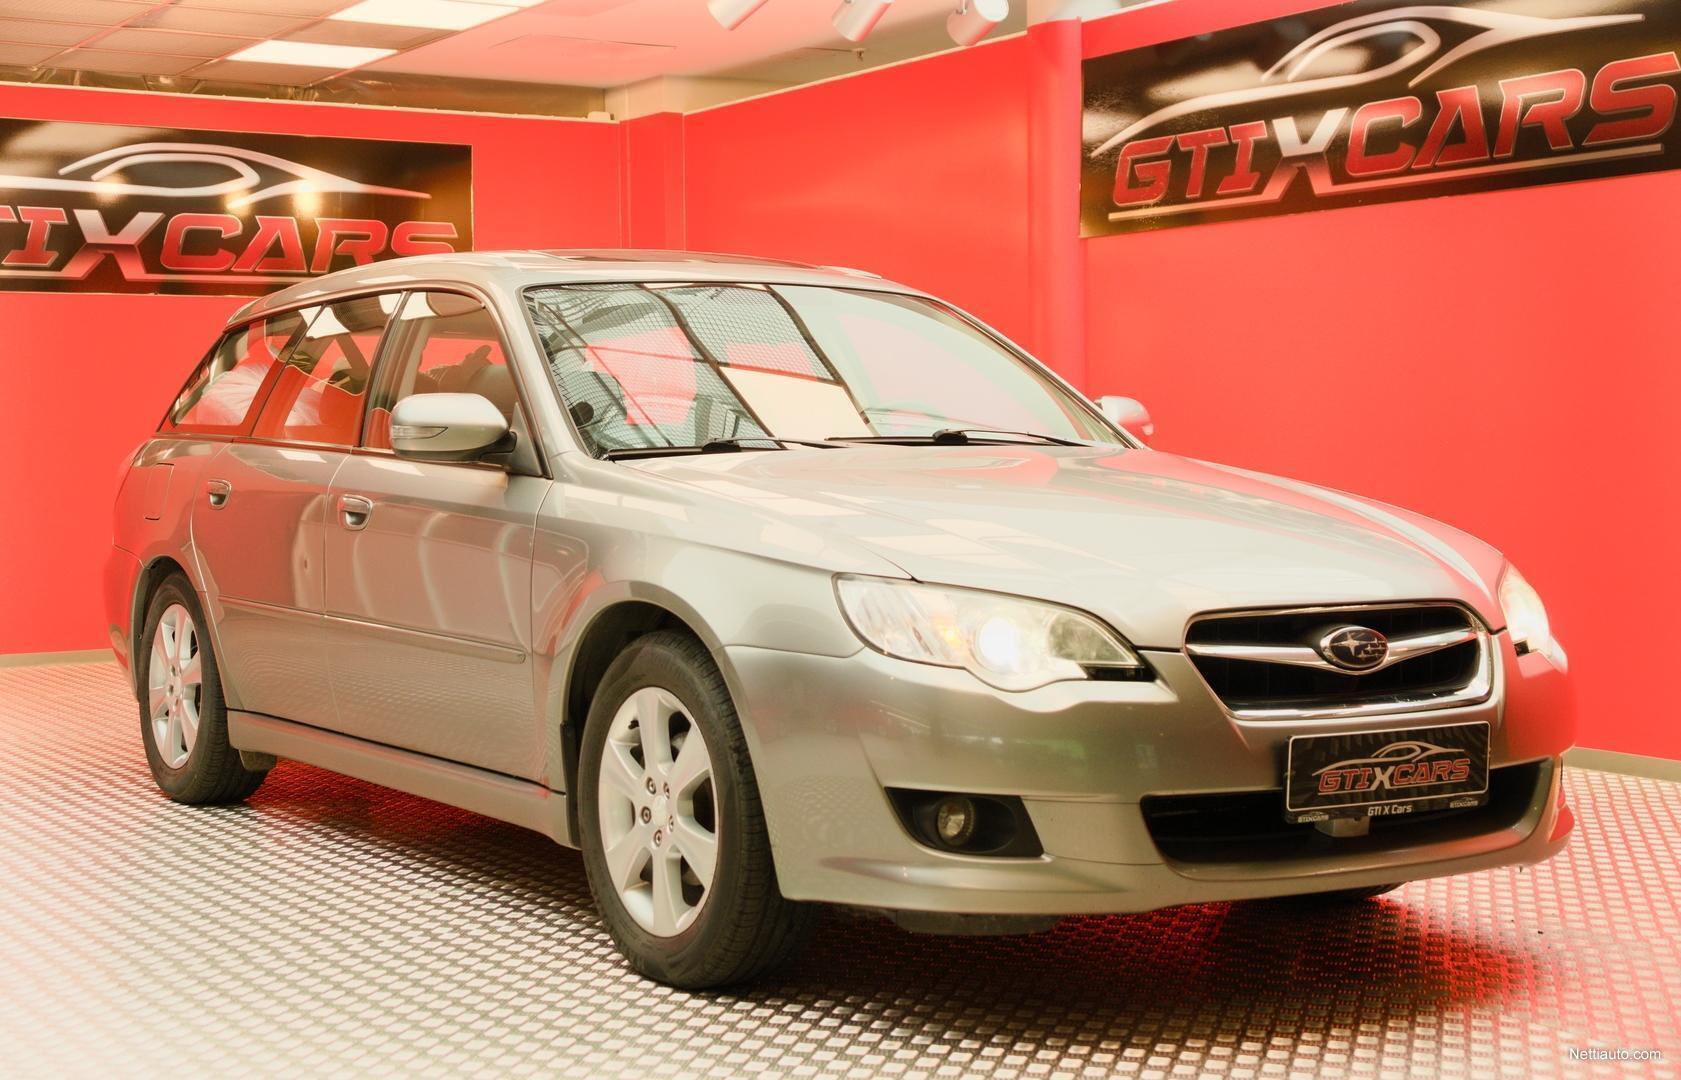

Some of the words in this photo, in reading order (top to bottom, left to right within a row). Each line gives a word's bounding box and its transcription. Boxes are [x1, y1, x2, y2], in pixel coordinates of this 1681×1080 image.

[1113, 52, 1681, 206] GTIXCARS
[0, 205, 459, 280] IXCARS
[1318, 759, 1470, 793] GTIXCARS
[1368, 806, 1381, 816] GTI
[1383, 805, 1390, 815] X
[1391, 804, 1412, 814] Cars
